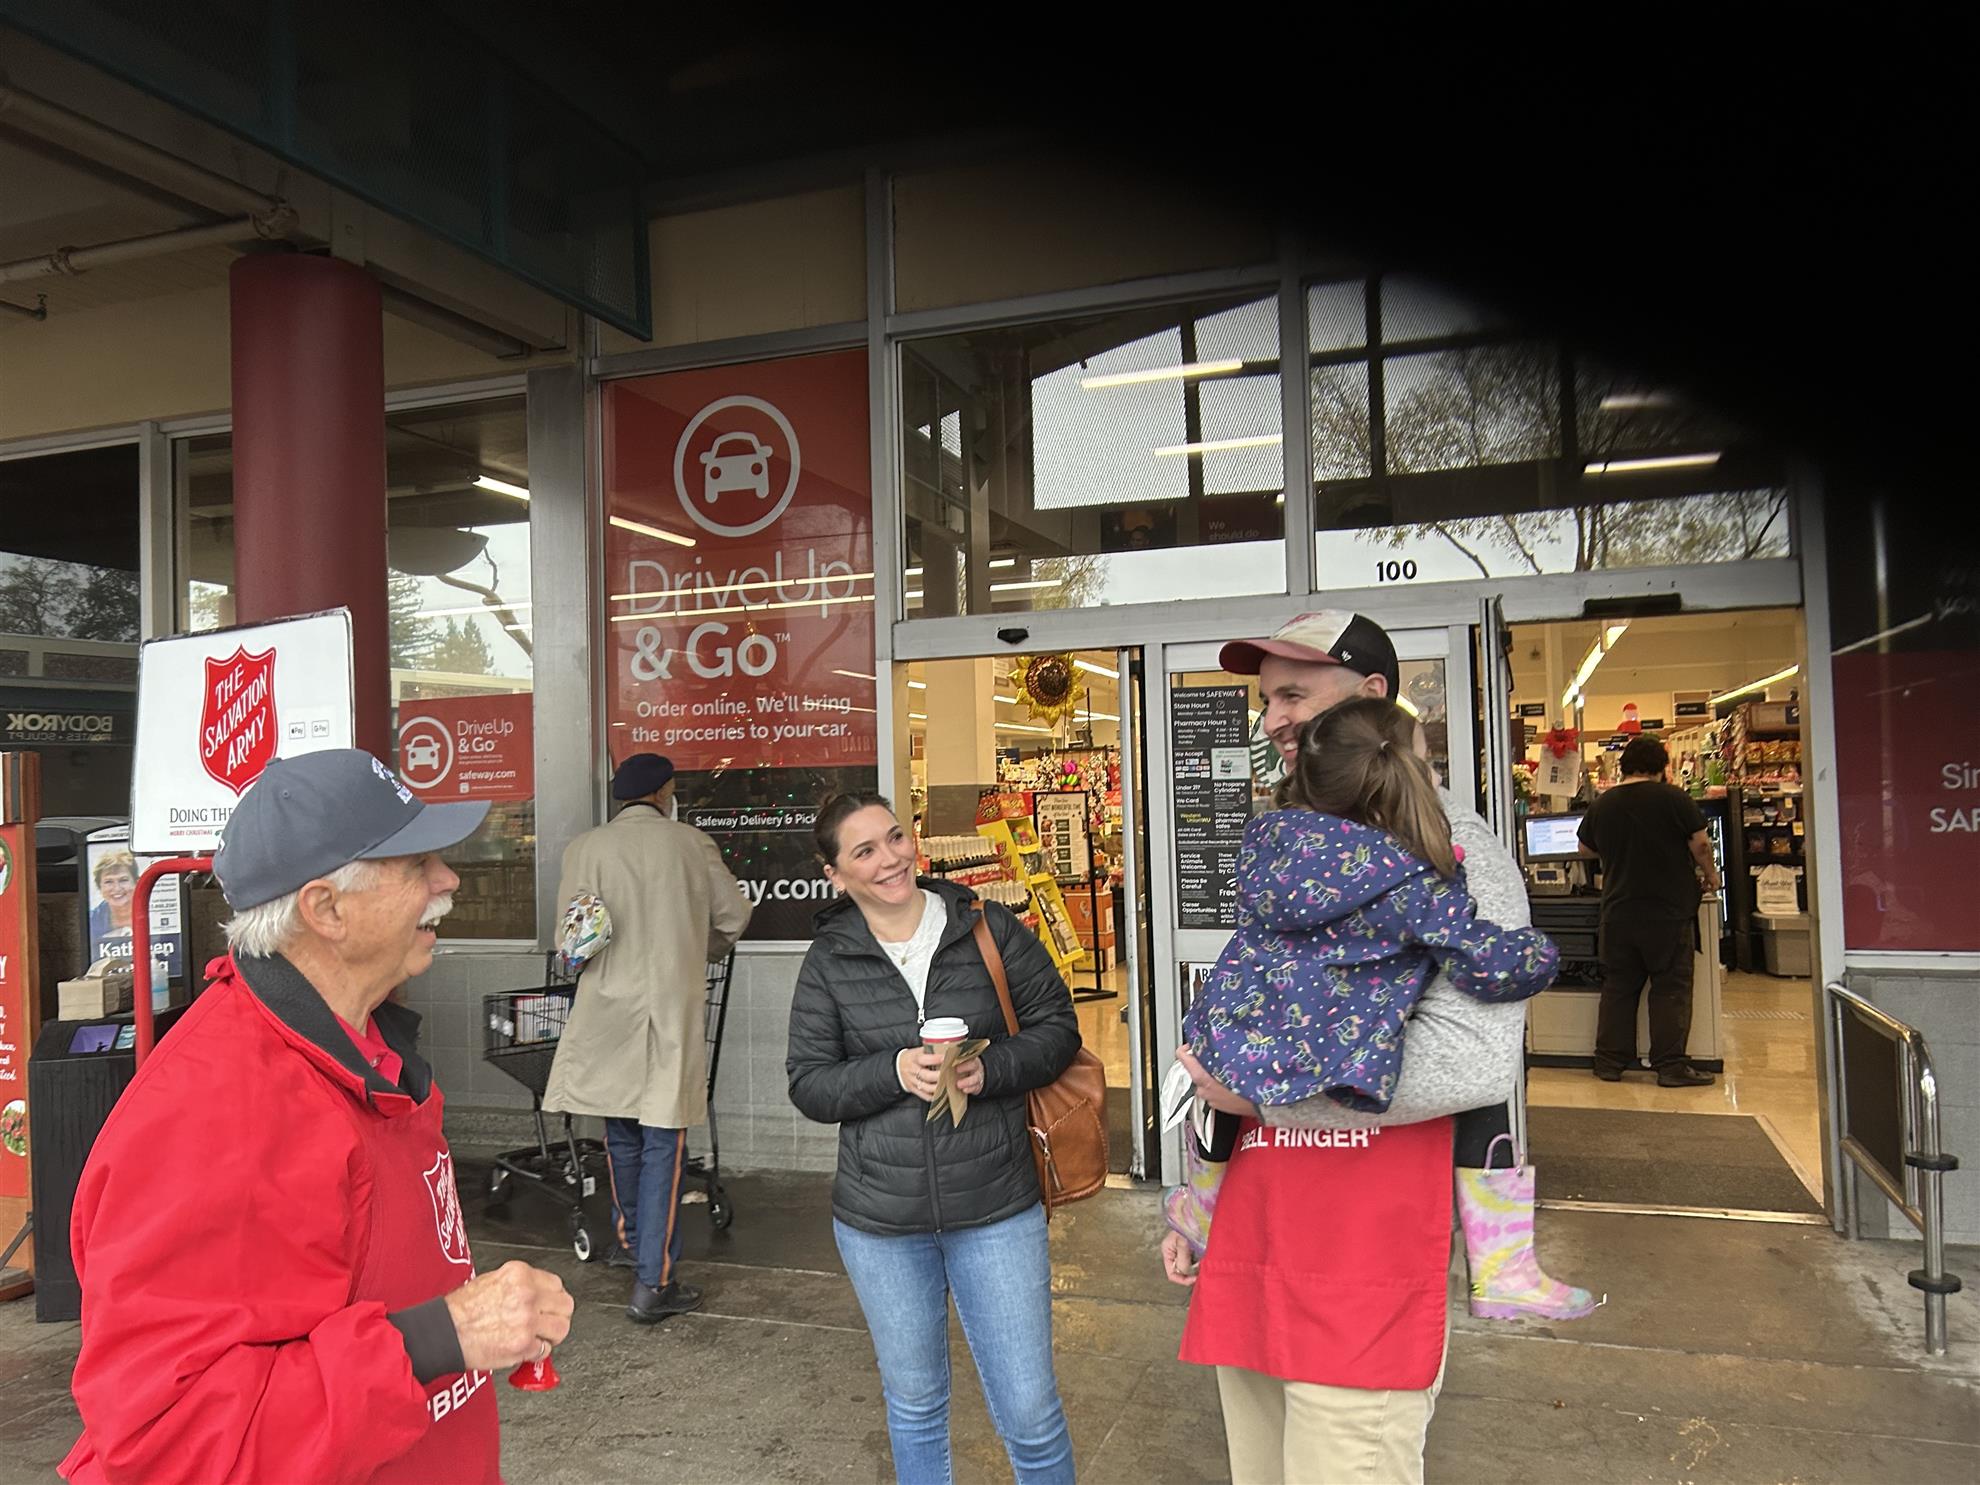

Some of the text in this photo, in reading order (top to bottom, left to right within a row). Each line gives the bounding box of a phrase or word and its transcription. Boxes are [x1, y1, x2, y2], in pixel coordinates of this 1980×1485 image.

[1376, 559, 1418, 582] 100
[628, 548, 855, 619] DriveUp
[630, 622, 778, 682] & Go
[215, 663, 245, 711] THE
[1206, 690, 1237, 698] SAFEWAY
[205, 664, 268, 758] SALVATION
[637, 694, 850, 718] Order online. We'll bring
[1173, 702, 1190, 710] Store
[457, 719, 514, 737] DriveUp
[1173, 719, 1207, 727] Pharmacy
[226, 707, 267, 777] ARMY
[632, 722, 852, 746] the groceries to your car.
[458, 737, 495, 753] & Go
[458, 770, 516, 781] safeway.com
[1222, 781, 1246, 789] Propane
[170, 807, 208, 823] DOING
[695, 815, 738, 829] Safeway
[740, 814, 784, 828] Delivery
[795, 812, 818, 825] Pick
[736, 878, 839, 908] ay.com
